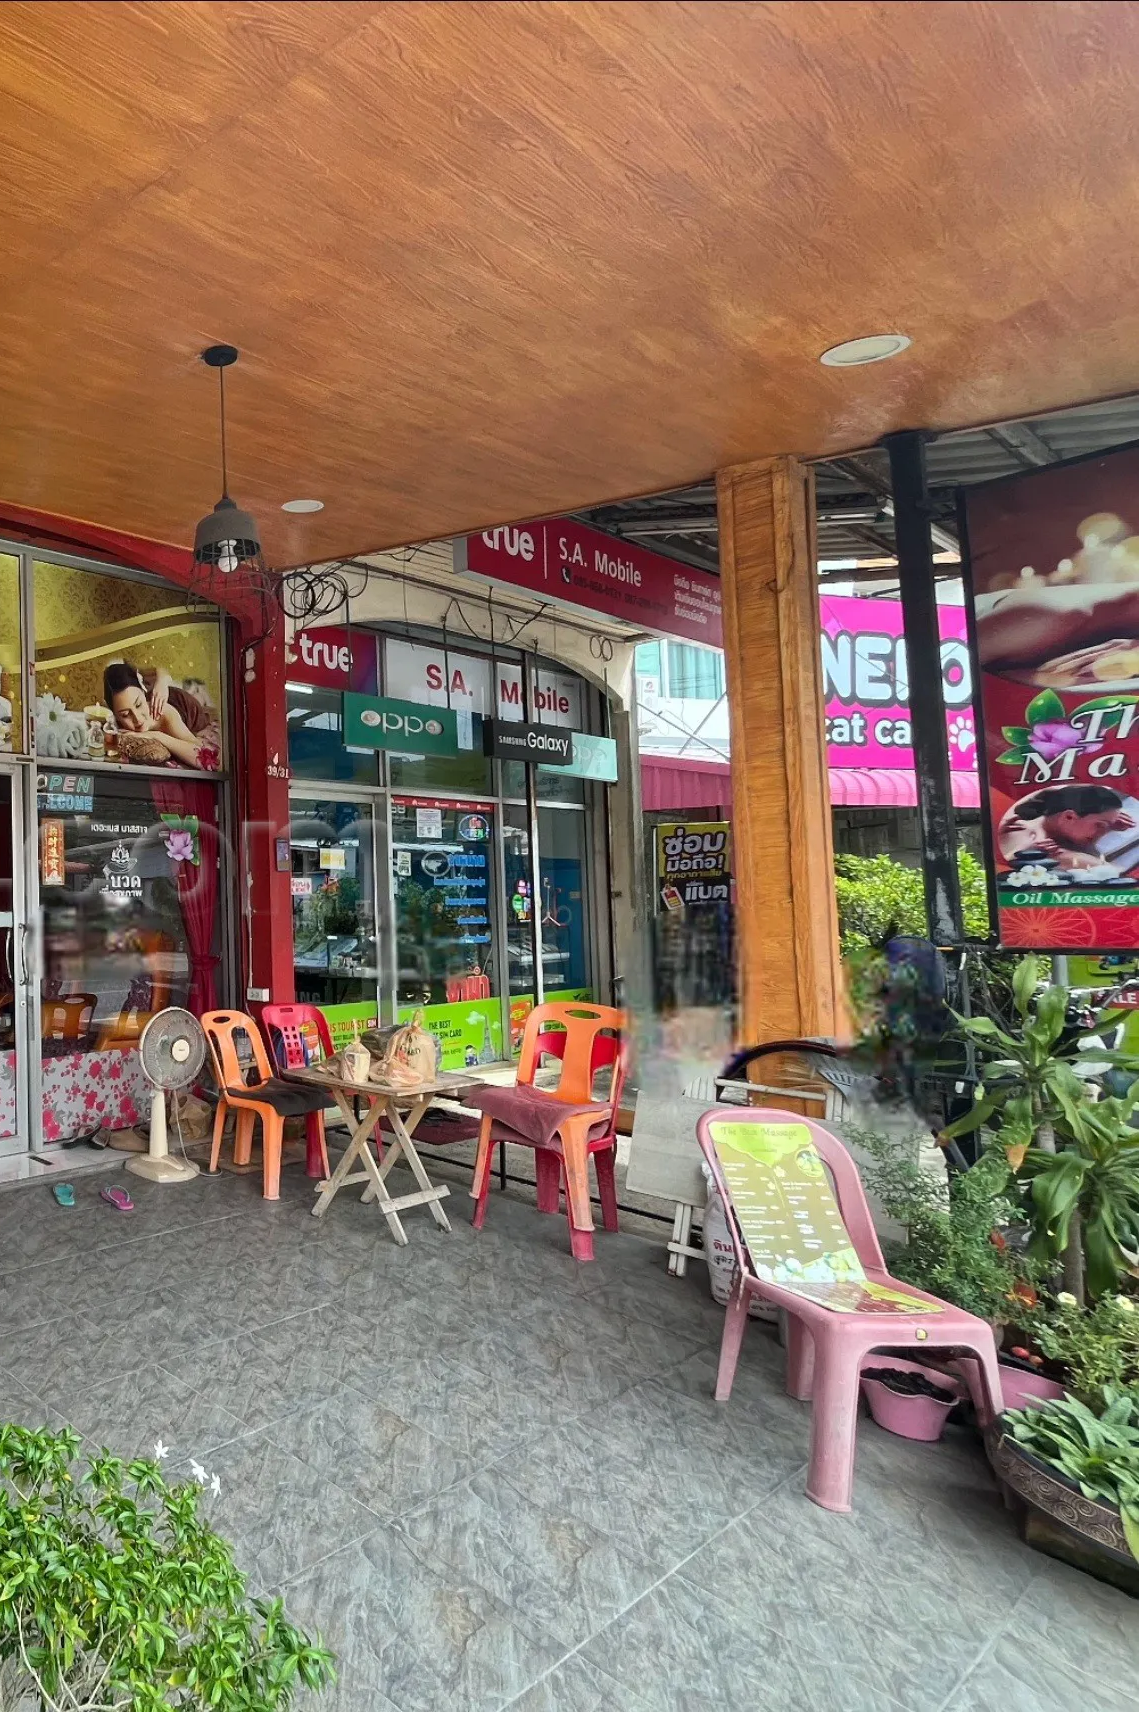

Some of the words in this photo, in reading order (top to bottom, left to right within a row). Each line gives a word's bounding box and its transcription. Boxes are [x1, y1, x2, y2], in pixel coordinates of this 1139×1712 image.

[482, 526, 534, 561] true
[559, 538, 588, 567] S.A.
[594, 550, 642, 588] Mobile
[299, 633, 353, 672] true
[426, 663, 473, 697] S.A.
[499, 735, 526, 747] SAMSUNG
[527, 732, 568, 756] Galaxy
[267, 764, 289, 779] 39/31
[36, 773, 91, 793] OPEN
[664, 827, 725, 855] ซ่อม
[110, 874, 141, 888] นวด
[684, 884, 728, 901] แบต
[1012, 892, 1042, 905] Oil
[340, 1019, 366, 1031] TOURST
